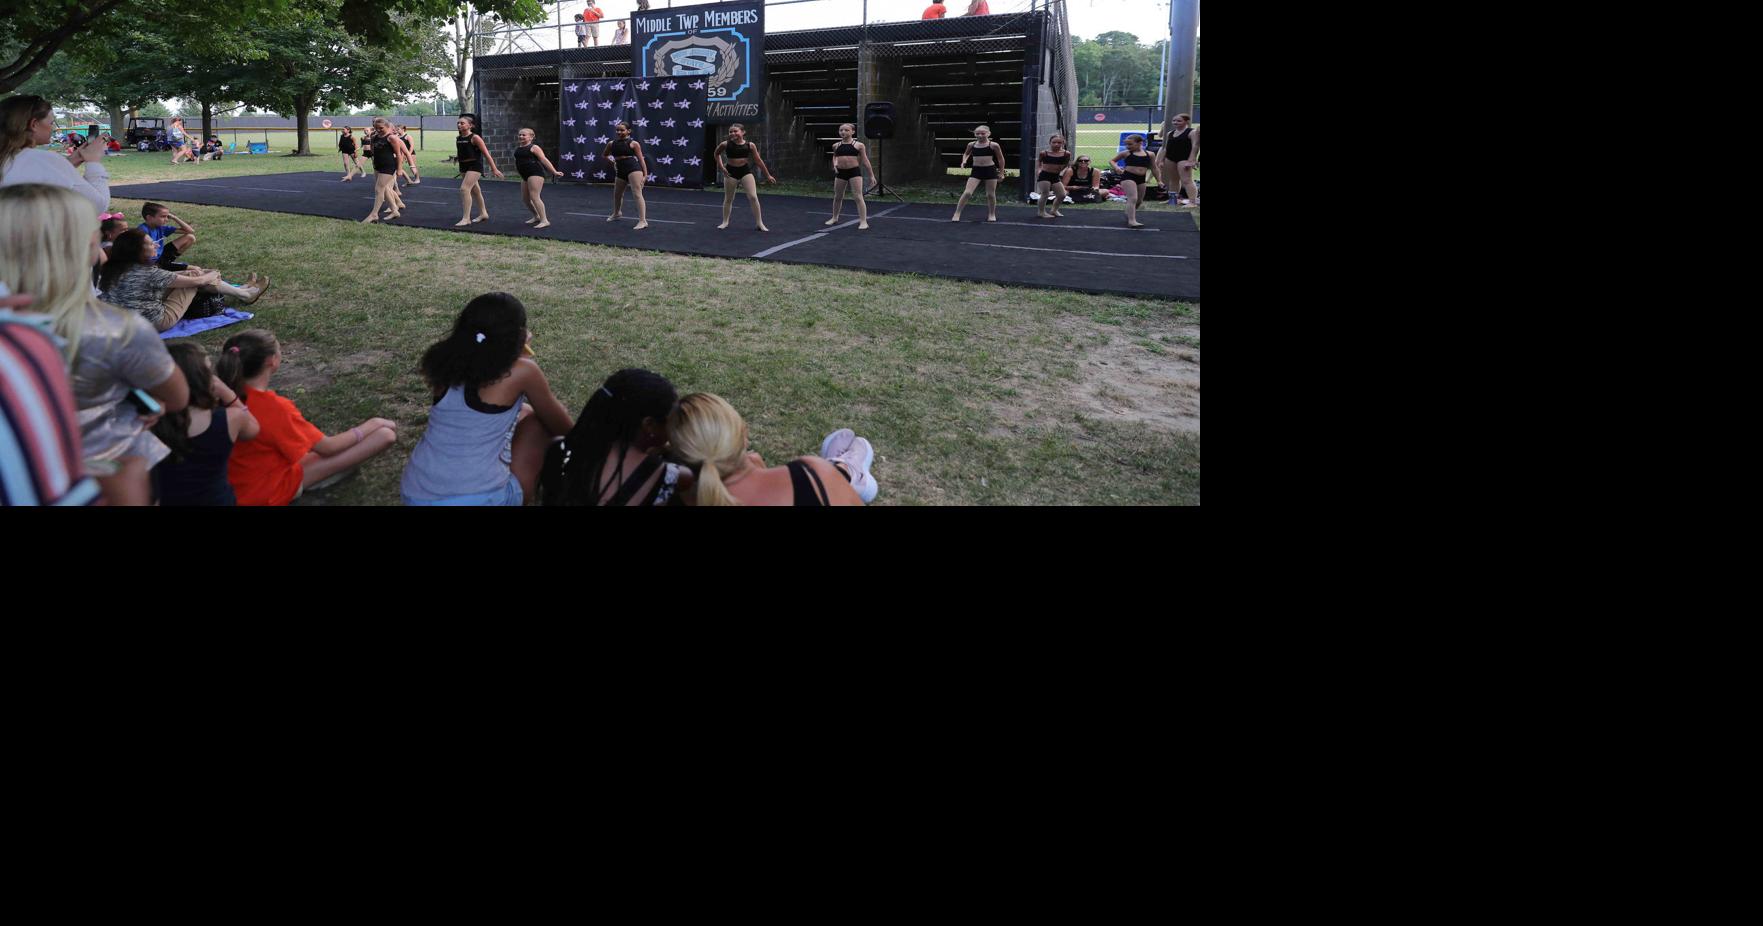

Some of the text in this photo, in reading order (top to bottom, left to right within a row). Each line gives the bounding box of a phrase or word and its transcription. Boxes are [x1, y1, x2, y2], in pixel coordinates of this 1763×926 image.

[636, 18, 672, 34] MIDDLE
[704, 9, 759, 28] MEMBERS
[712, 101, 759, 117] ACTIVITIES
